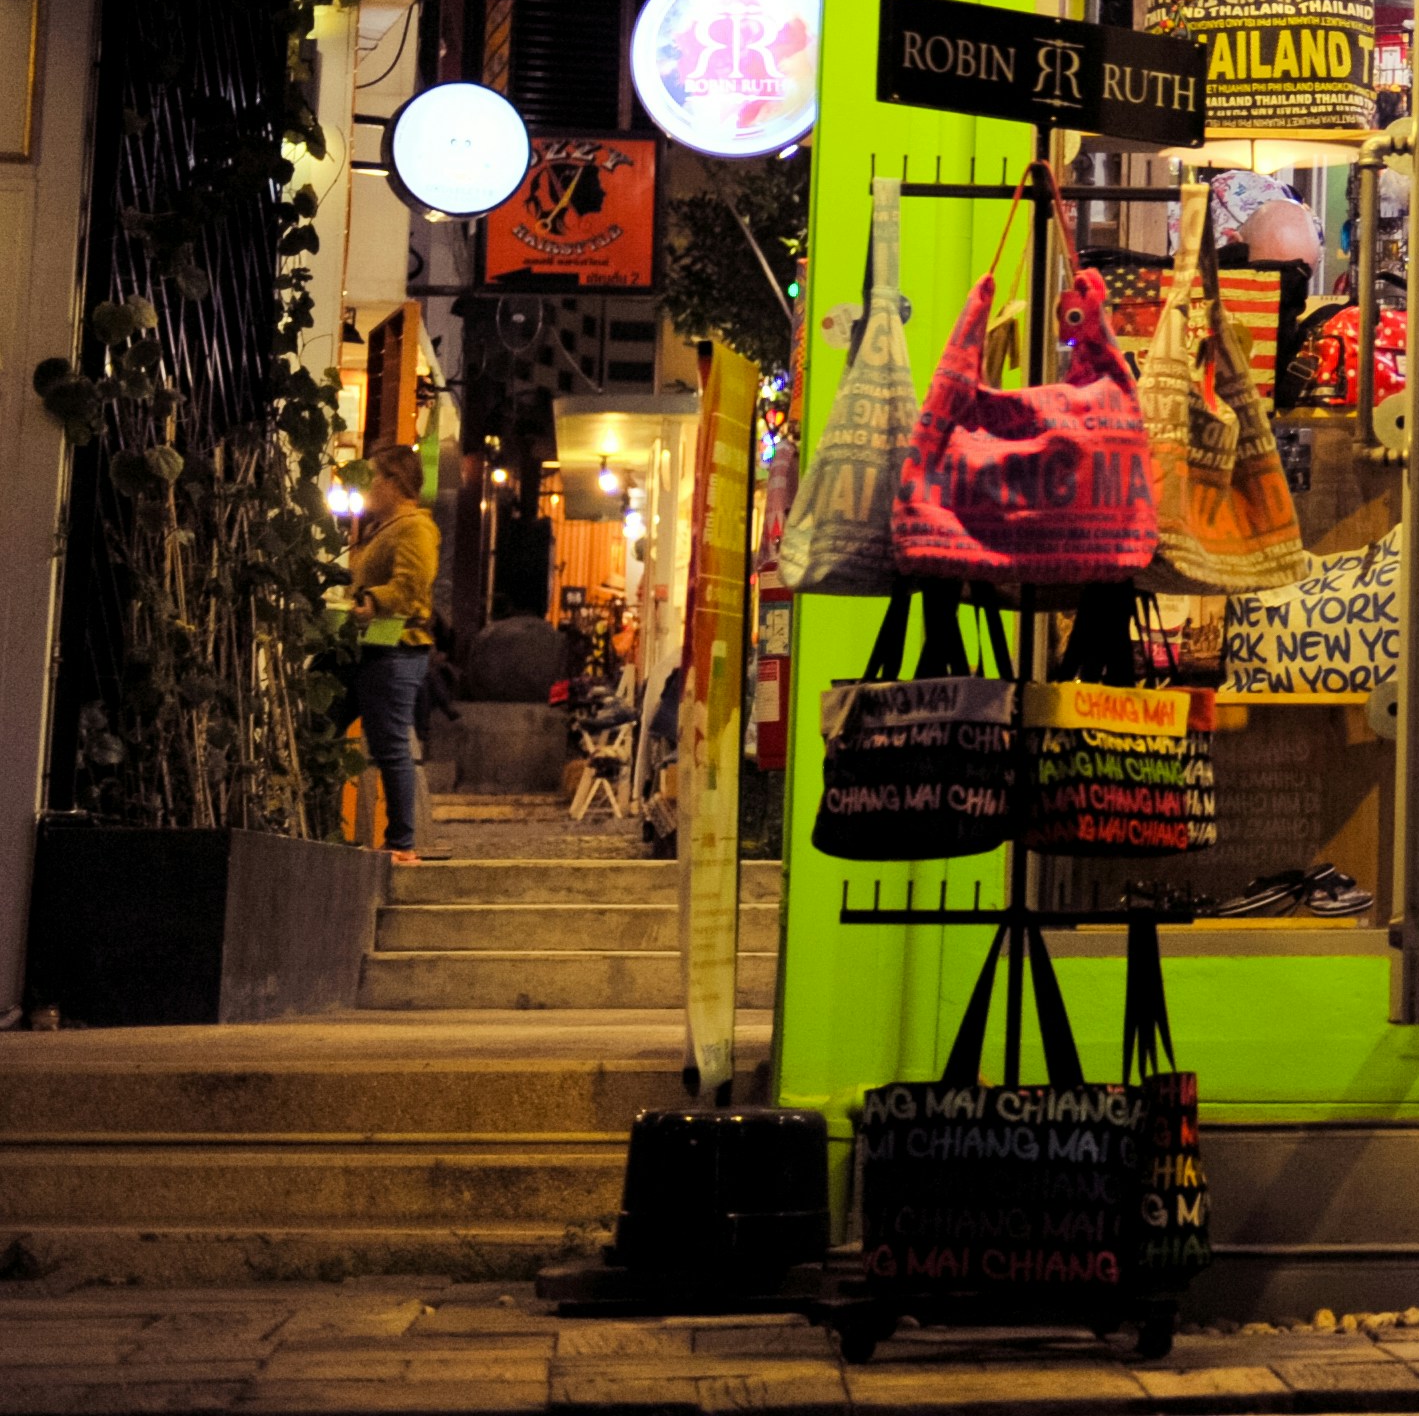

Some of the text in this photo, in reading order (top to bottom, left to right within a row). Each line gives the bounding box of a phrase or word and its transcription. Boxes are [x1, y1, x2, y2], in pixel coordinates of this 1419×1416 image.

[902, 30, 1017, 83] ROBIN
[1101, 62, 1197, 113] RUTH
[1199, 30, 1352, 81] AILAND
[1300, 591, 1400, 628] YORK
[1276, 627, 1351, 664] NEW
[825, 783, 901, 816] CHIANG
[924, 1086, 987, 1121] MAI
[995, 1086, 1128, 1126] CHIANG
[905, 1125, 1113, 1165] CHIANG MAI
[979, 1247, 1123, 1288] CHIANG
